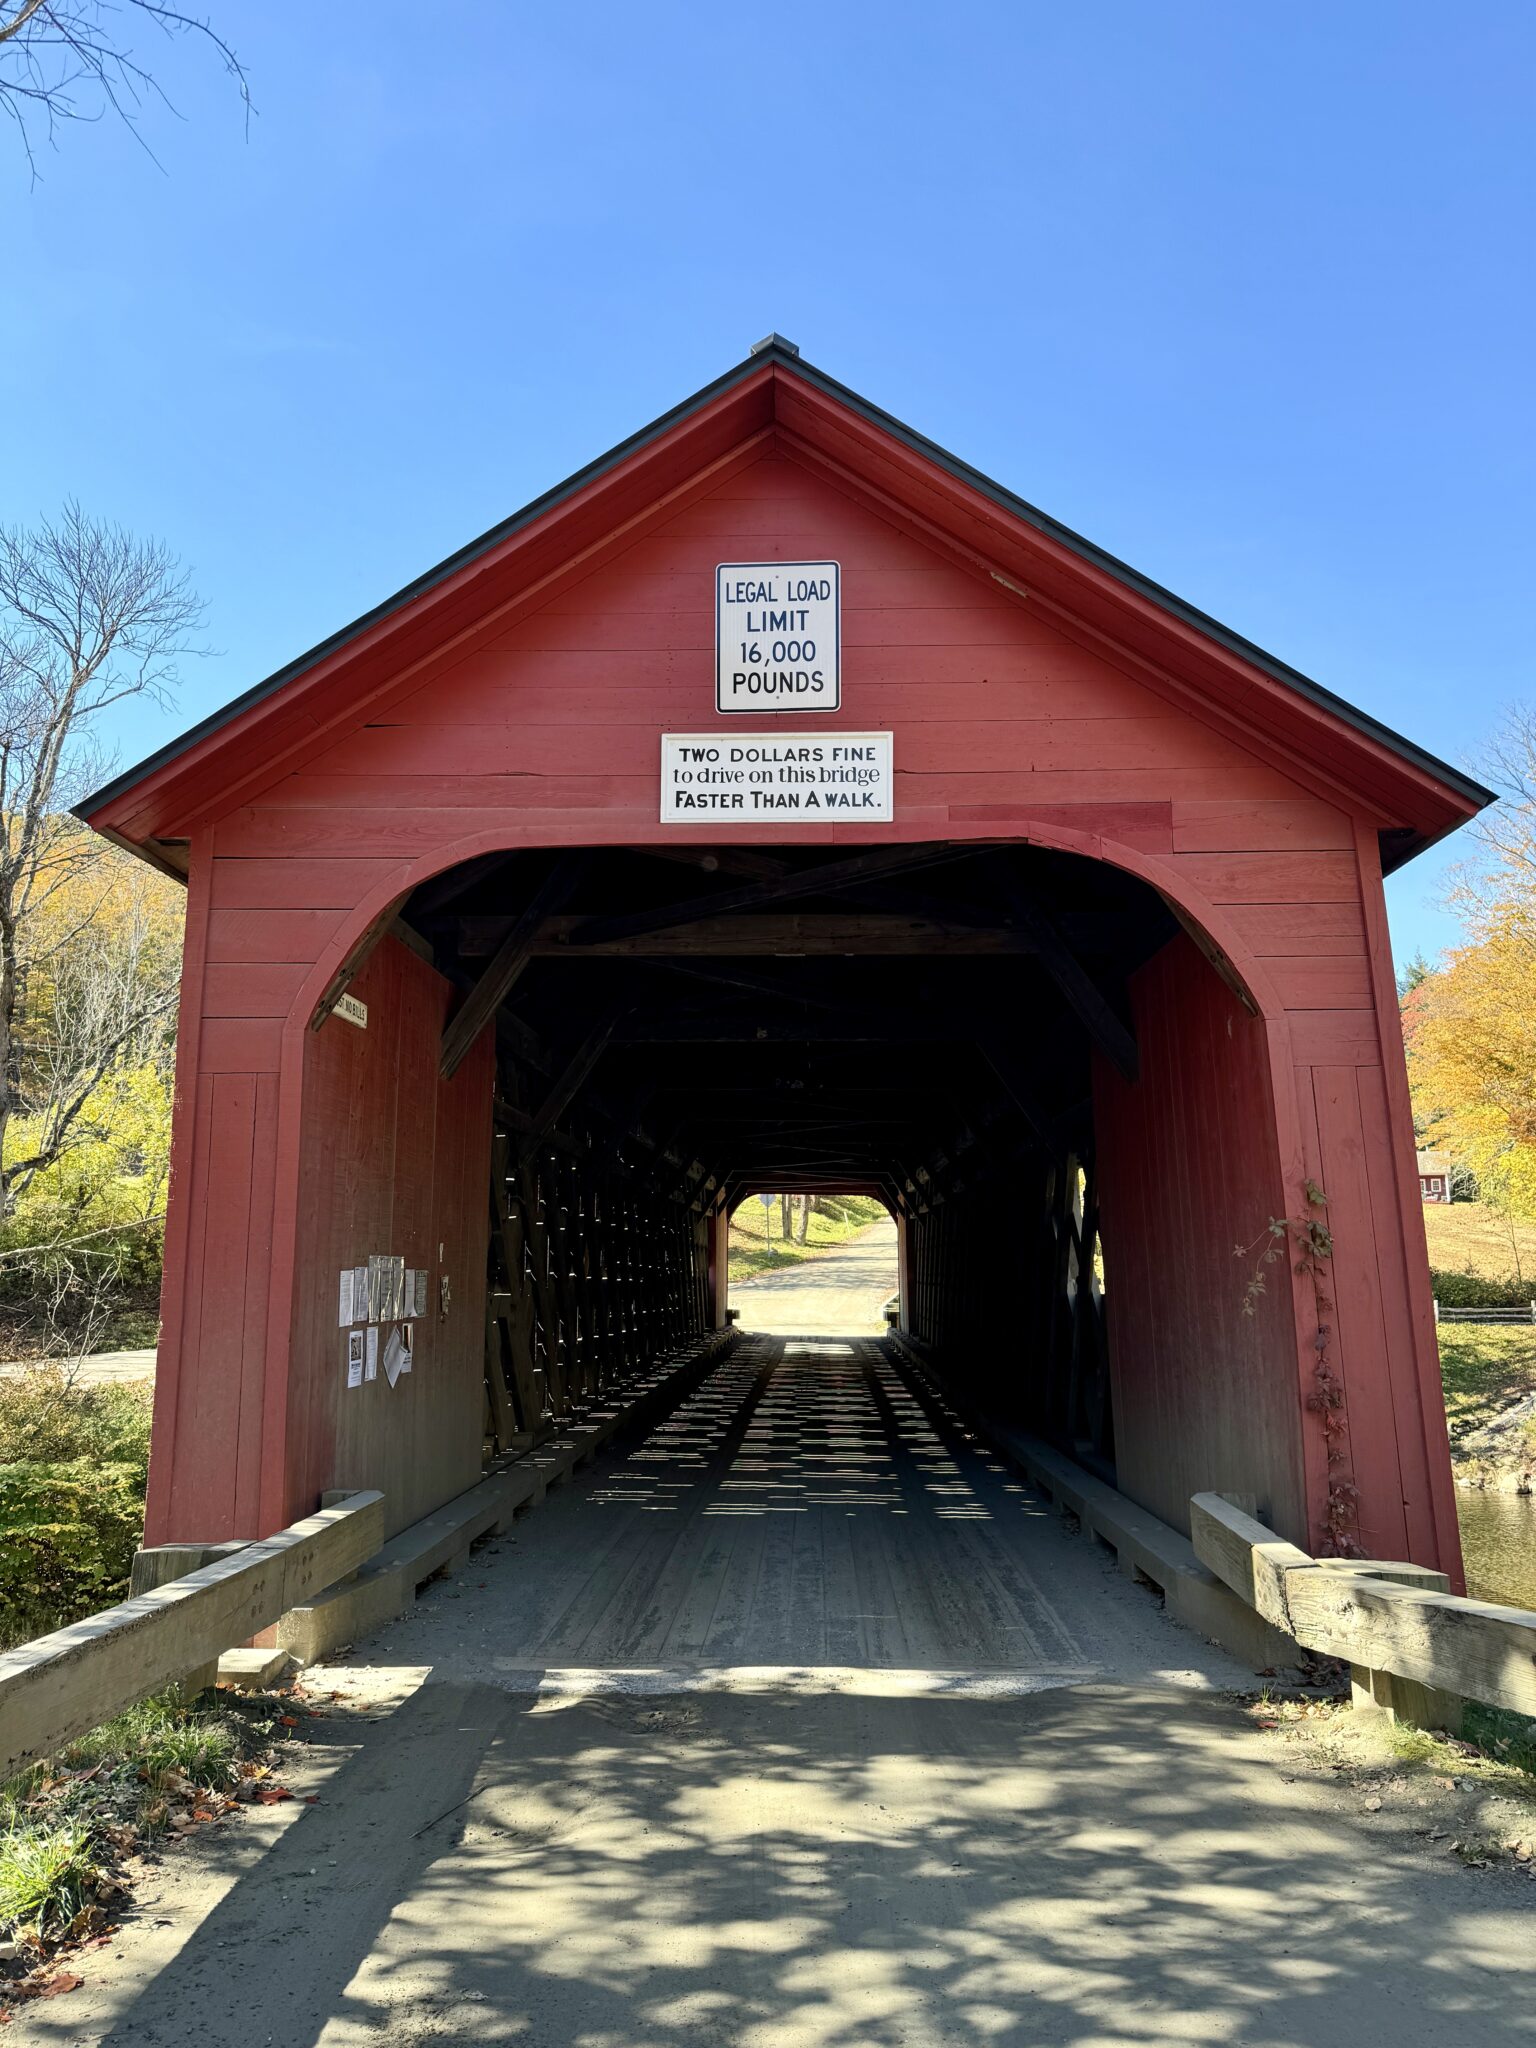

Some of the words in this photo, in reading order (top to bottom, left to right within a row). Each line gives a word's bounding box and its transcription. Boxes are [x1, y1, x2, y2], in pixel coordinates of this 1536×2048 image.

[725, 582, 778, 603] LEGAL
[788, 580, 831, 601] LOAD
[747, 610, 809, 632] LIMIT
[741, 640, 816, 667] 16,000
[733, 671, 824, 695] POUNDS
[679, 748, 720, 762] TWO
[731, 748, 824, 762] DOLLARS
[832, 747, 876, 761] FINE
[674, 768, 693, 783] to
[697, 767, 745, 783] drive
[749, 770, 773, 783] on
[779, 766, 816, 782] this
[819, 766, 880, 786] bridge
[675, 790, 744, 808] FASTER
[750, 790, 800, 808] THAN
[805, 790, 821, 808] A
[825, 792, 882, 808] WALK.
